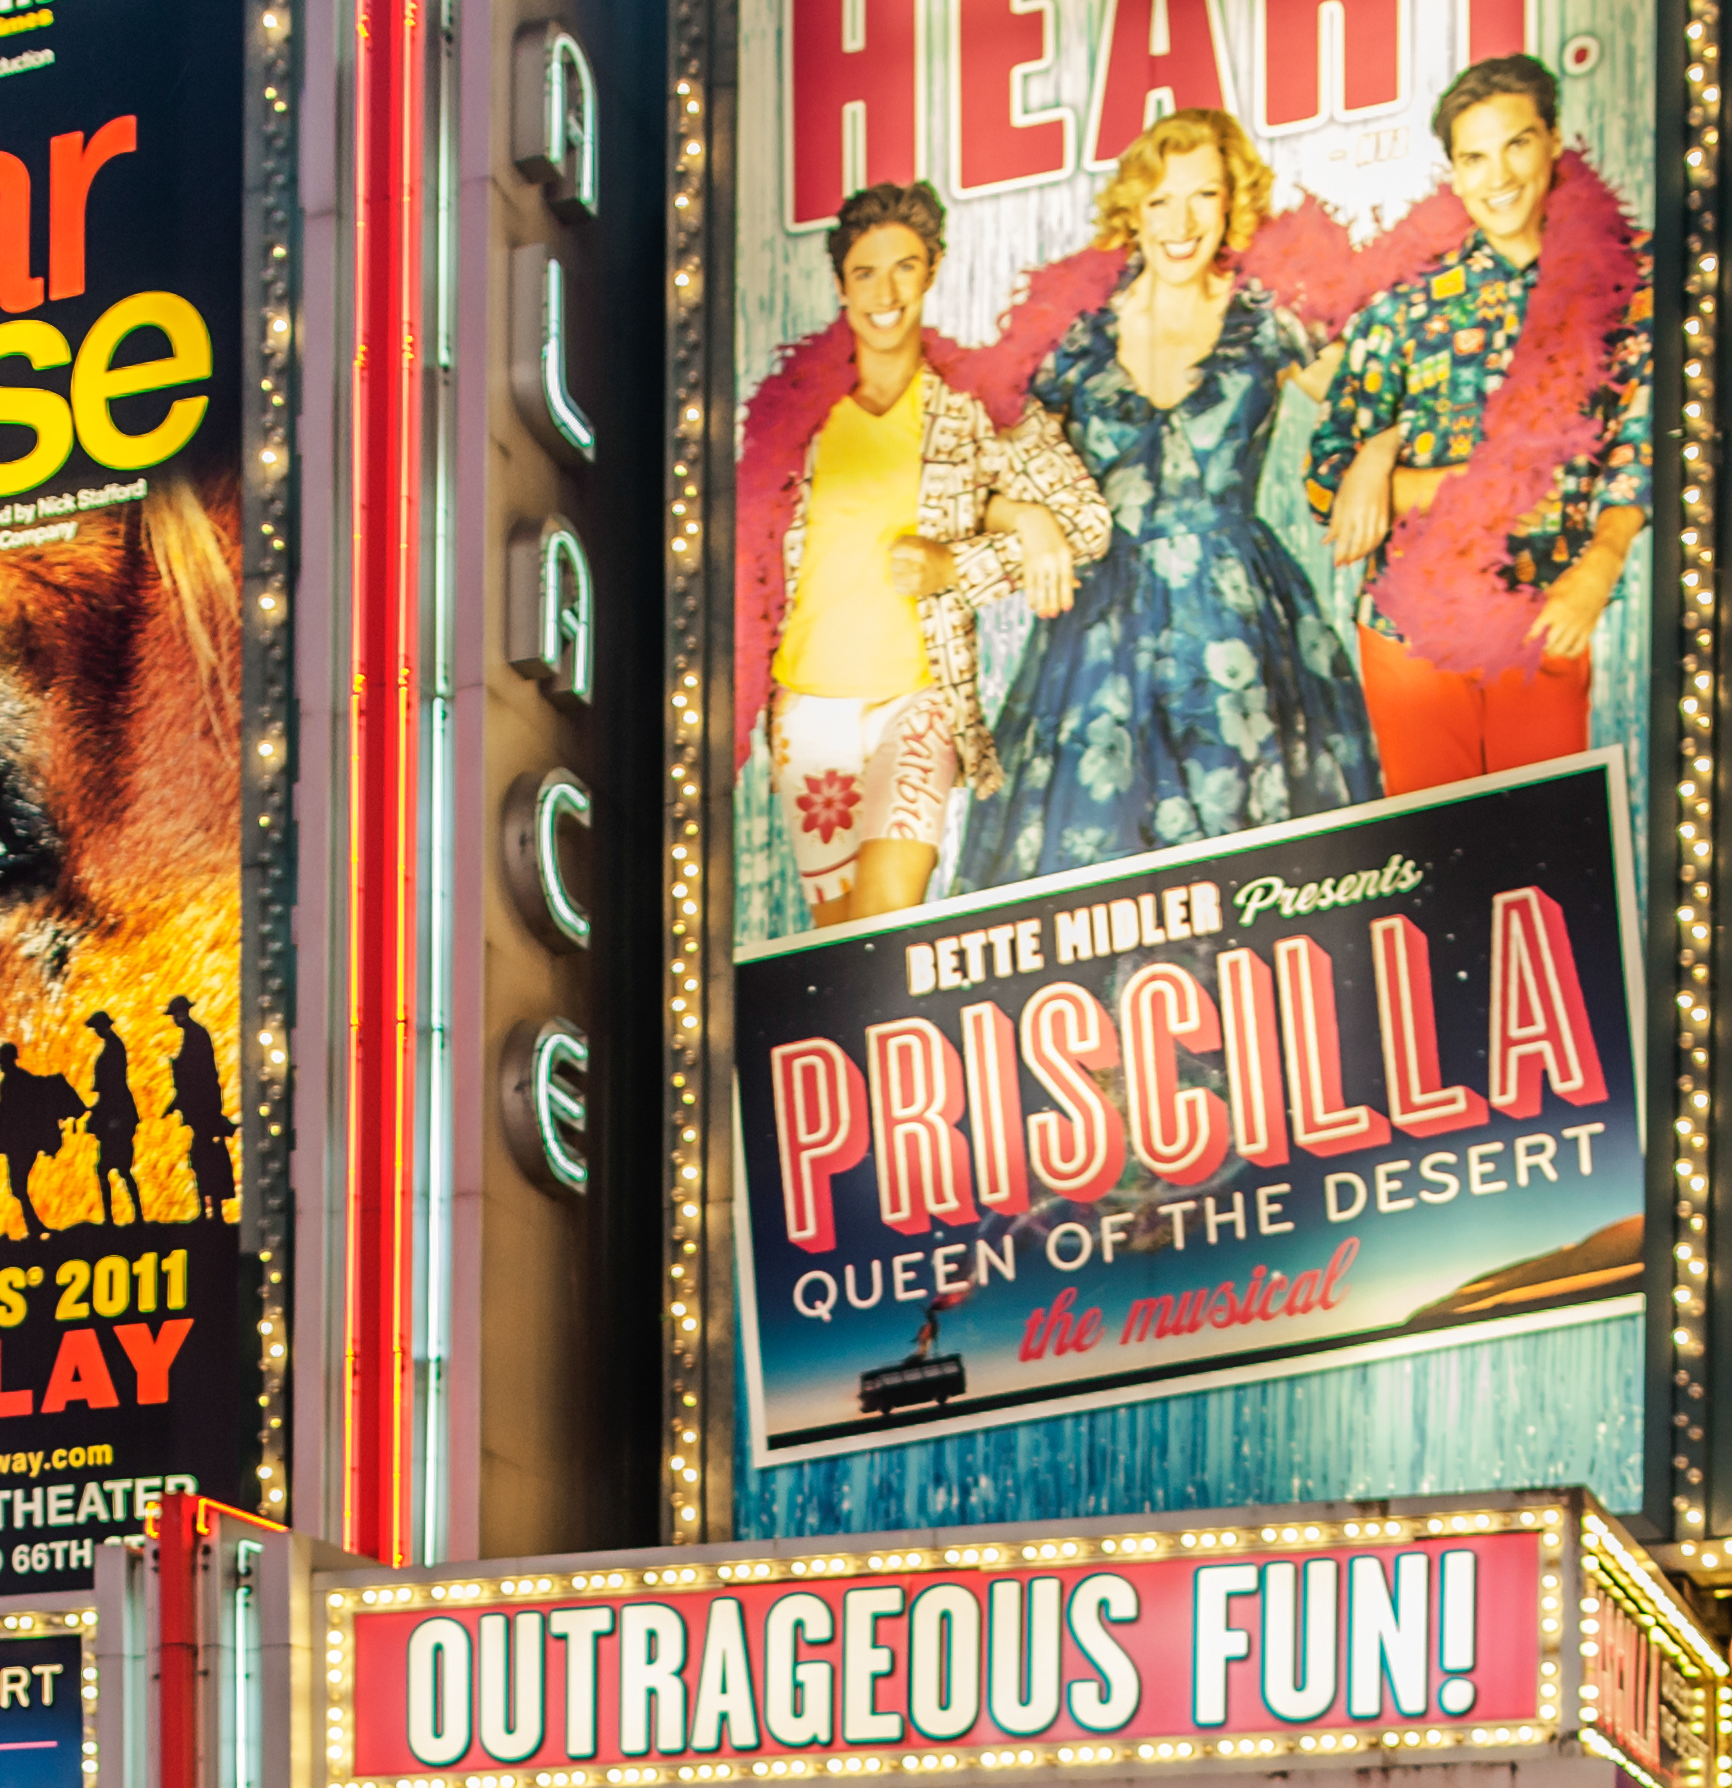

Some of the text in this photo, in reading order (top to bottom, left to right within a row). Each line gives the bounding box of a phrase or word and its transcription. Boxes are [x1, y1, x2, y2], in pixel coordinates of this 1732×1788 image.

[11, 502, 35, 526] by
[37, 491, 76, 518] Nick
[76, 477, 149, 512] Stafford
[905, 852, 1424, 997] BETTE MIDLER Presents
[770, 884, 1608, 1256] PRISCILLA
[55, 1249, 189, 1321] 2011
[792, 1120, 1607, 1323] QUEEN OF THE DESERT
[1018, 1235, 1362, 1365] the musical
[10, 1537, 93, 1573] 66TH
[406, 1572, 1142, 1767] OUTRAGEOUS
[1191, 1548, 1477, 1729] FUN!
